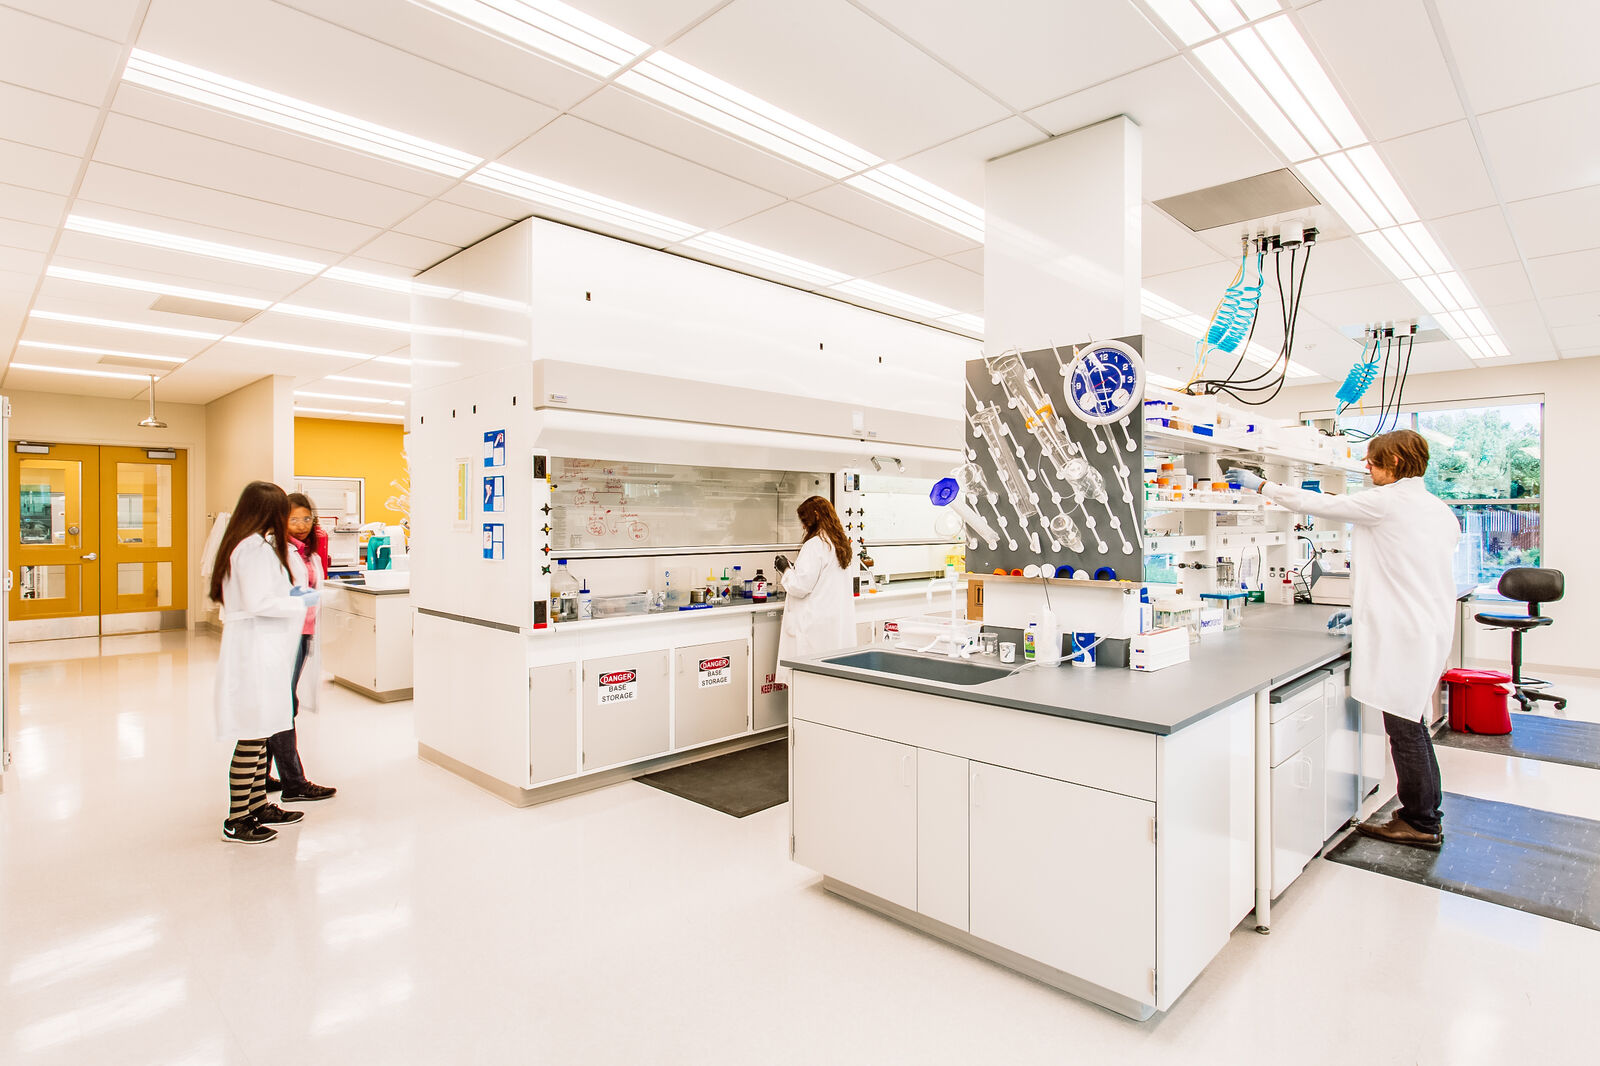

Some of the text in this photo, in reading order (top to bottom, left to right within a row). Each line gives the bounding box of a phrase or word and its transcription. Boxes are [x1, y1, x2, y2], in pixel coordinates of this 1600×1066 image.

[1100, 353, 1108, 361] 12
[1122, 363, 1129, 371] 2
[1076, 382, 1082, 390] 9
[703, 660, 727, 669] DANGER
[603, 673, 632, 683] DANGER
[701, 676, 728, 687] STORAGE
[608, 683, 627, 693] BASE
[760, 683, 772, 695] KEEP
[601, 691, 633, 703] STORAGE
